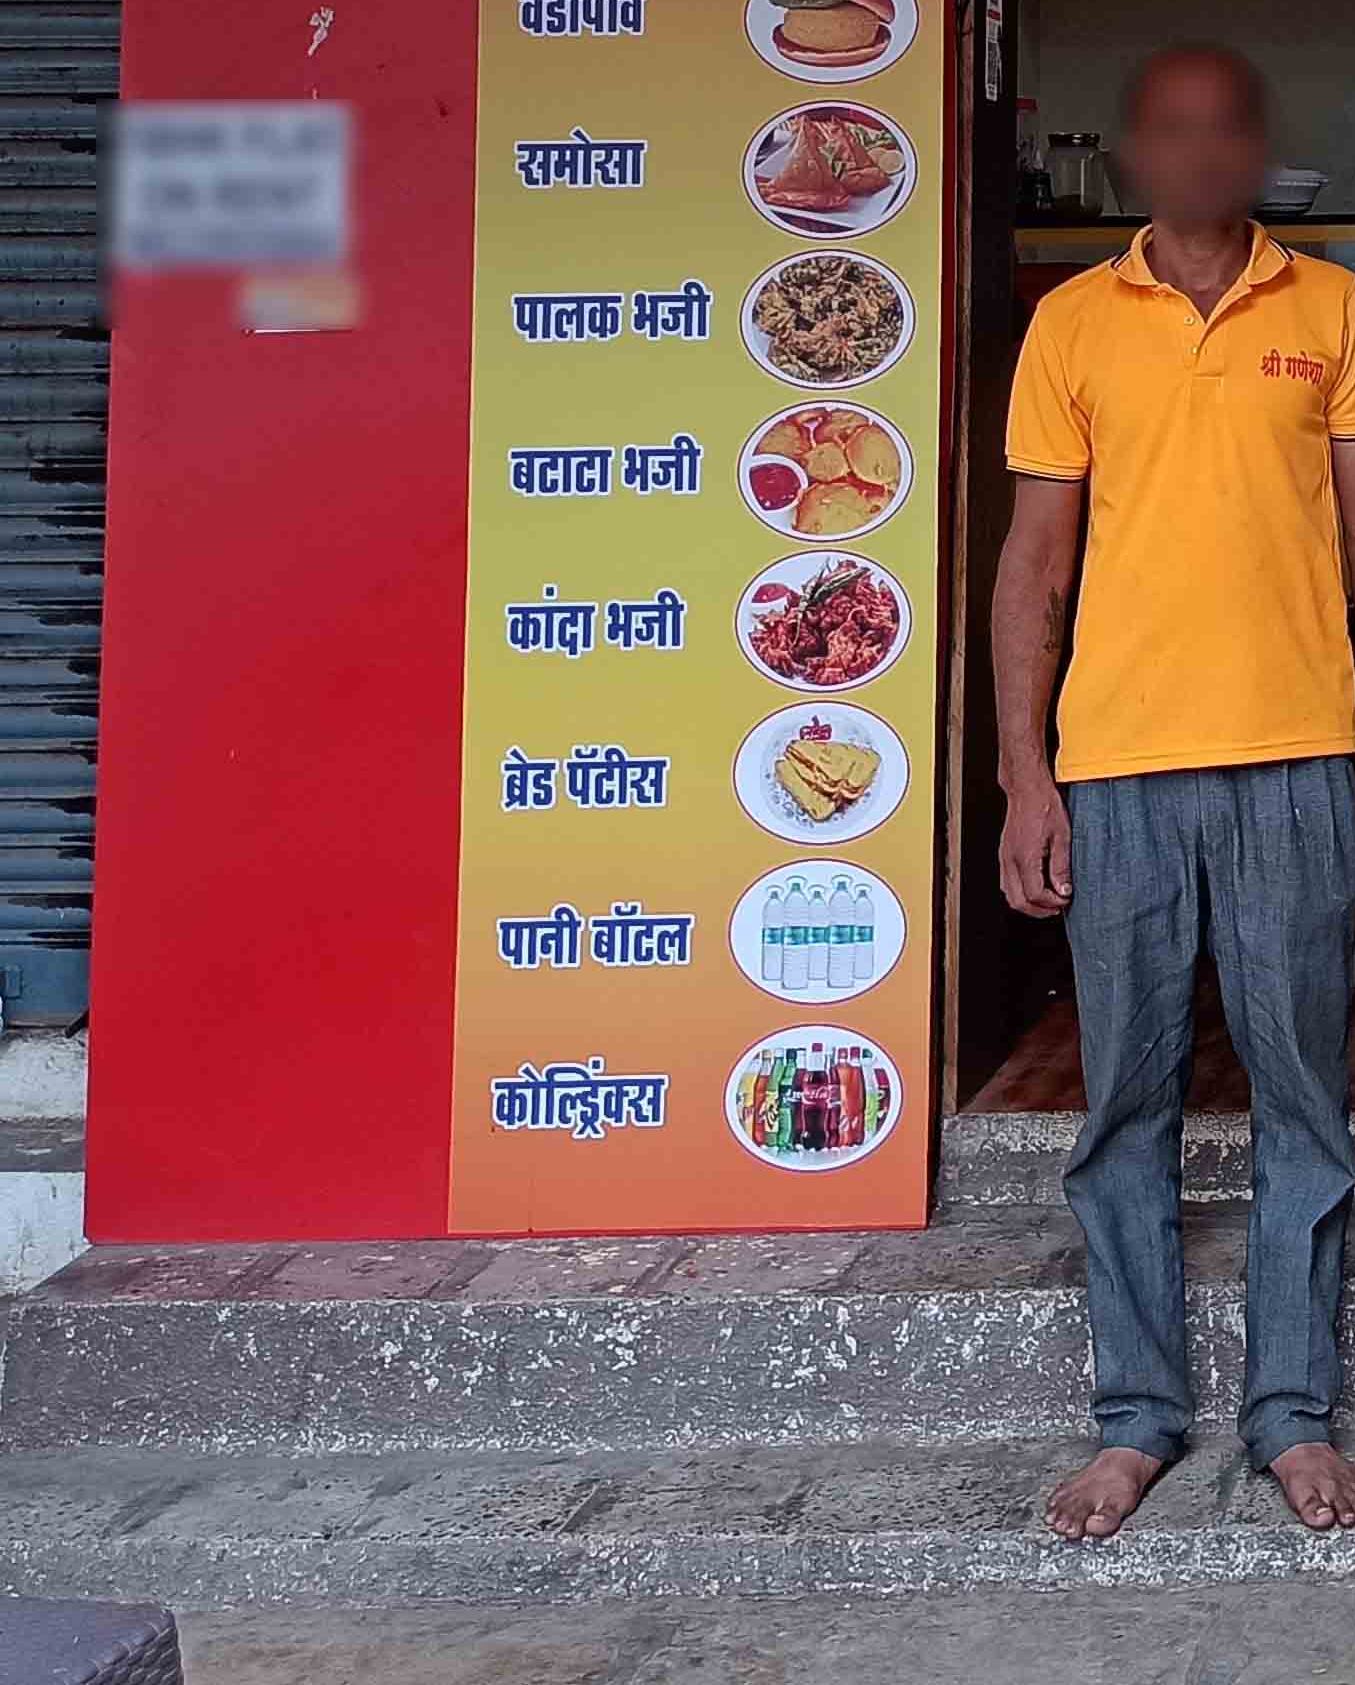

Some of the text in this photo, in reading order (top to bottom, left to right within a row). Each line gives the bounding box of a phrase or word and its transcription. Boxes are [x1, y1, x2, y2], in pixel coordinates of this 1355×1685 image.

[516, 127, 647, 188] समोसा
[512, 279, 711, 341] पालक भजी
[1260, 348, 1281, 378] श्री
[508, 433, 703, 496] बटाटा भजी
[505, 584, 687, 657] कांदा भजी
[501, 745, 670, 811] ब्रेड पॅटीस
[497, 902, 695, 968] पानी बॉटल
